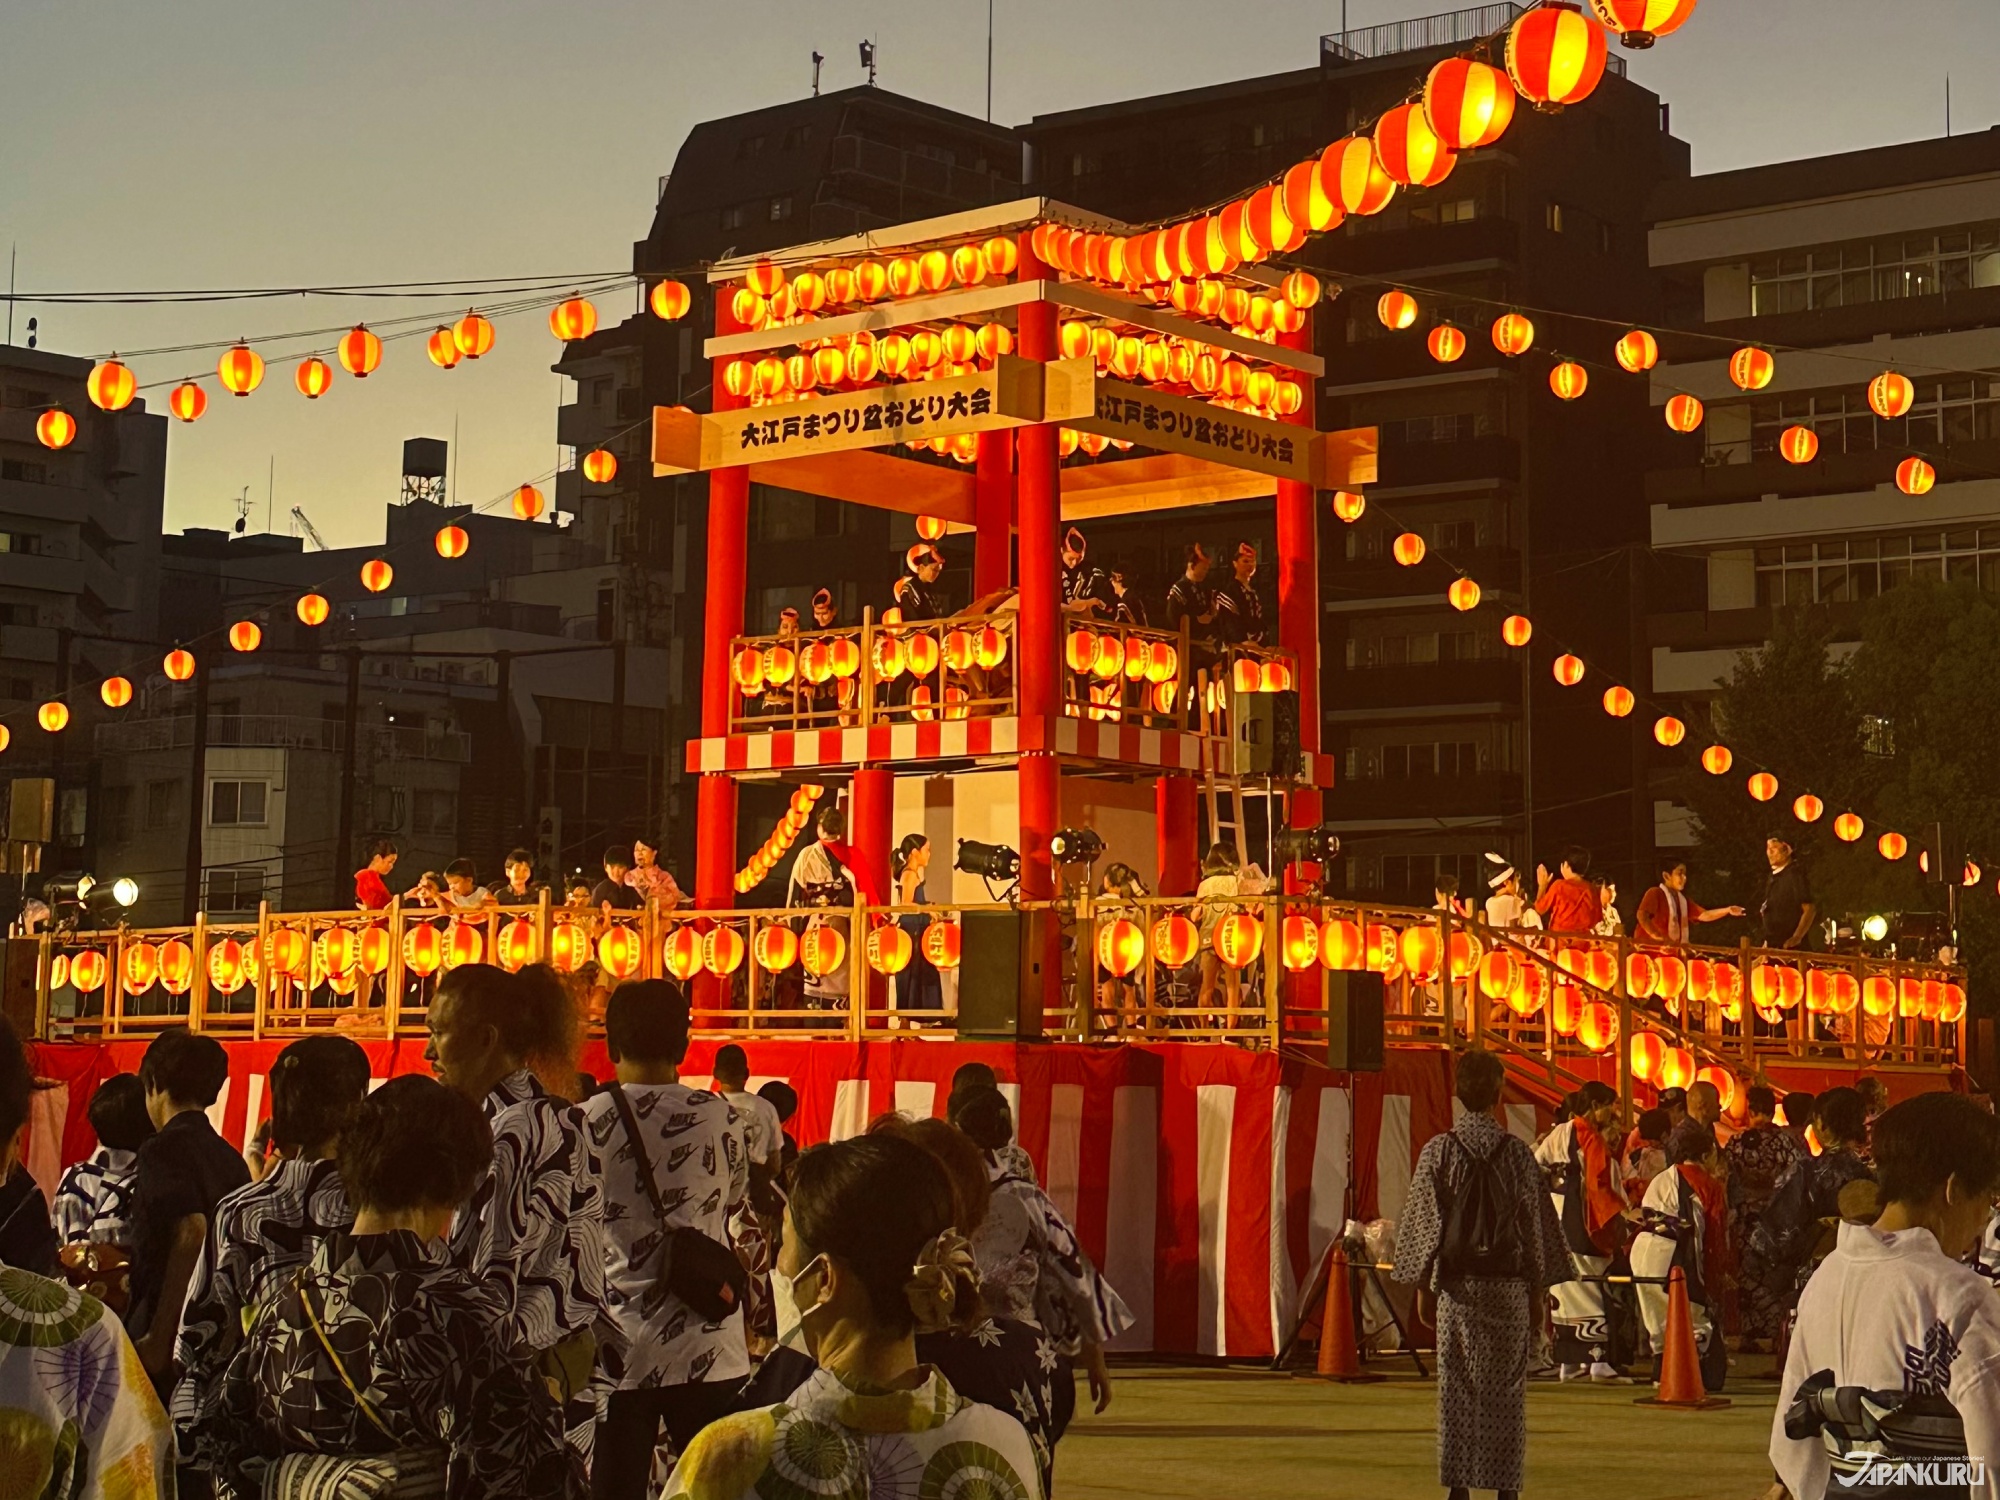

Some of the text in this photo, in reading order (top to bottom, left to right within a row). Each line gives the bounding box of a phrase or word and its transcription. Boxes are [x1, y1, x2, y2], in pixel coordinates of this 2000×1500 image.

[741, 388, 991, 448] 大江戸まつり盆おどり大会
[593, 1107, 617, 1136] NIKE
[668, 1112, 698, 1128] NIKE
[661, 1186, 688, 1206] NIKE
